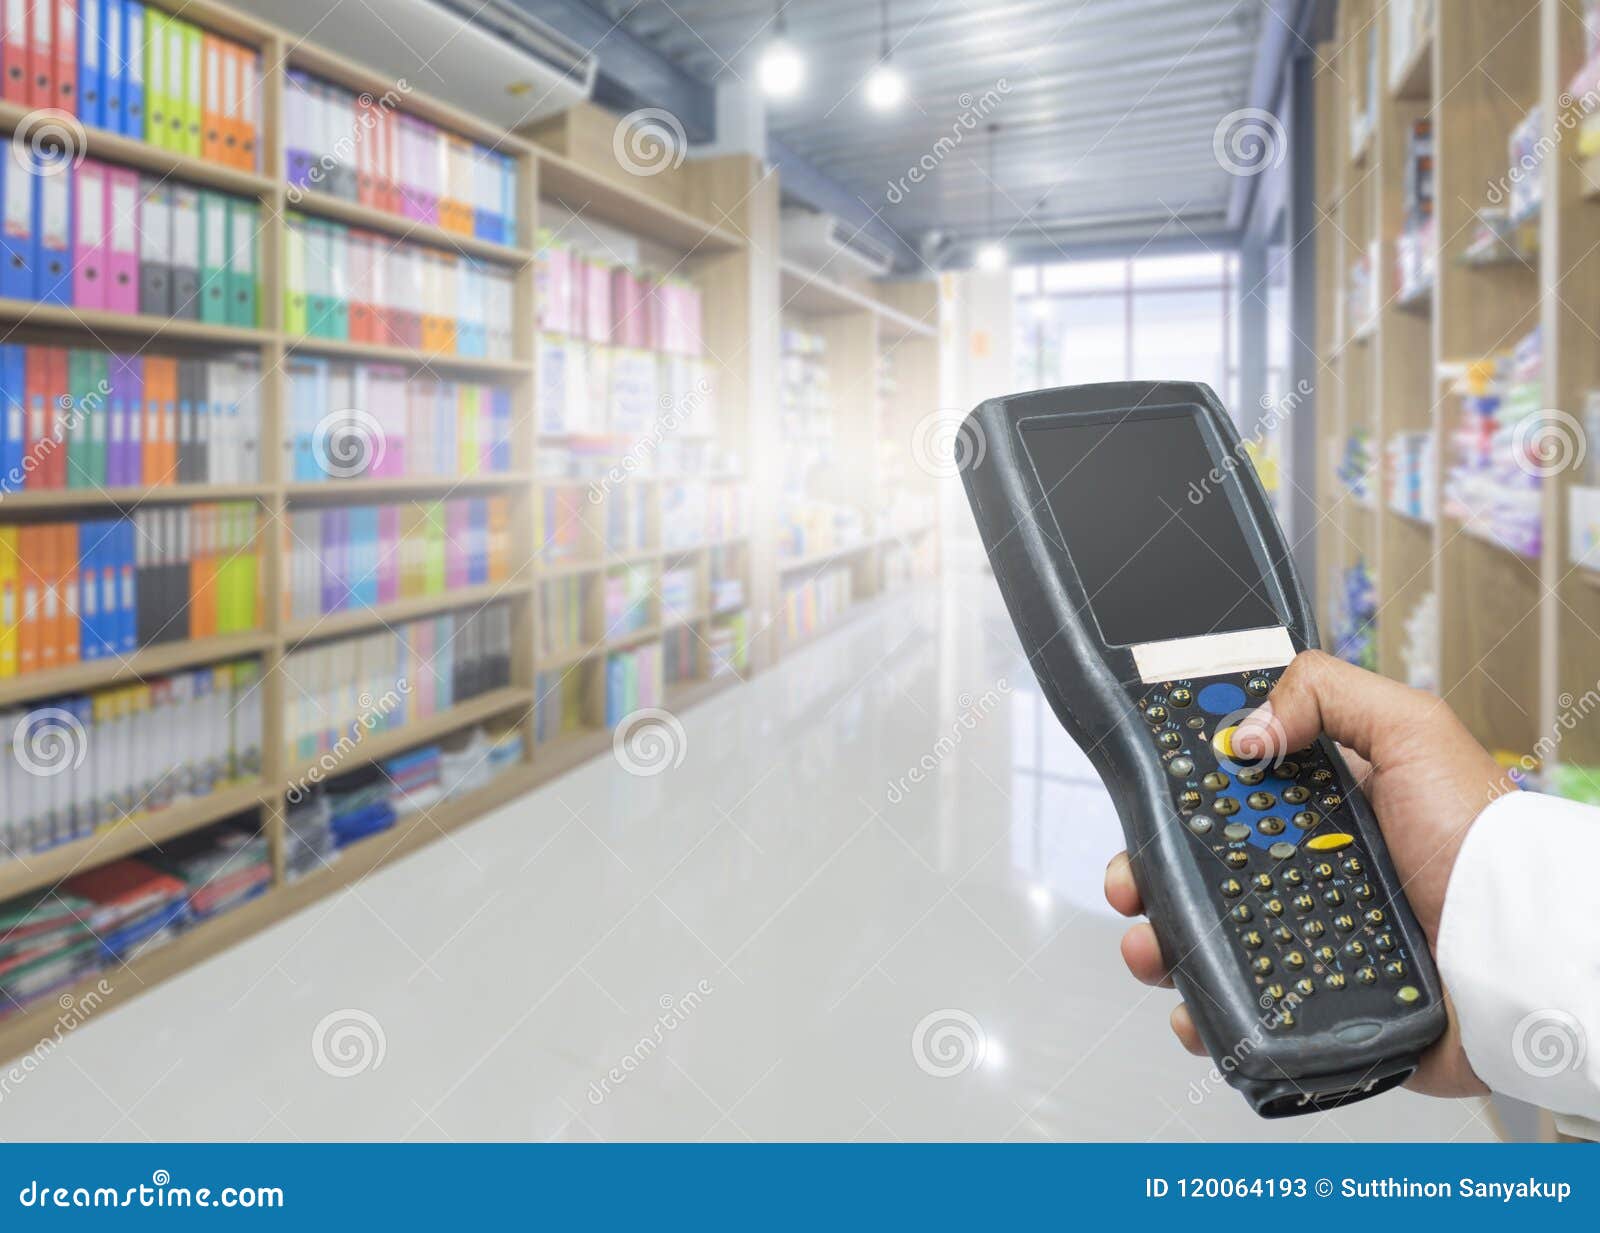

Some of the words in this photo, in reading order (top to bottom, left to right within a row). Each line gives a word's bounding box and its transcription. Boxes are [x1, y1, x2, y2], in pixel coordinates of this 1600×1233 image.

[1253, 680, 1267, 690] F4
[1176, 689, 1190, 701] F3
[1151, 707, 1165, 717] F2
[1164, 732, 1178, 743] F1
[1320, 863, 1332, 875] D
[1350, 858, 1361, 870] E
[1260, 873, 1271, 886] B
[1288, 868, 1300, 881] C
[1228, 879, 1240, 891] A
[1299, 894, 1313, 907] H
[1239, 904, 1249, 917] F
[1371, 909, 1383, 921] O
[1310, 920, 1324, 933] M
[1340, 915, 1353, 927] N
[1248, 931, 1261, 944] K
[1382, 934, 1391, 945] T
[1321, 947, 1333, 959] R
[1353, 941, 1363, 953] S
[1259, 957, 1270, 970] P
[1289, 951, 1304, 965] Q
[1363, 967, 1375, 979] X
[1392, 961, 1402, 974] Y
[1329, 974, 1345, 986] W
[1269, 984, 1283, 998] U
